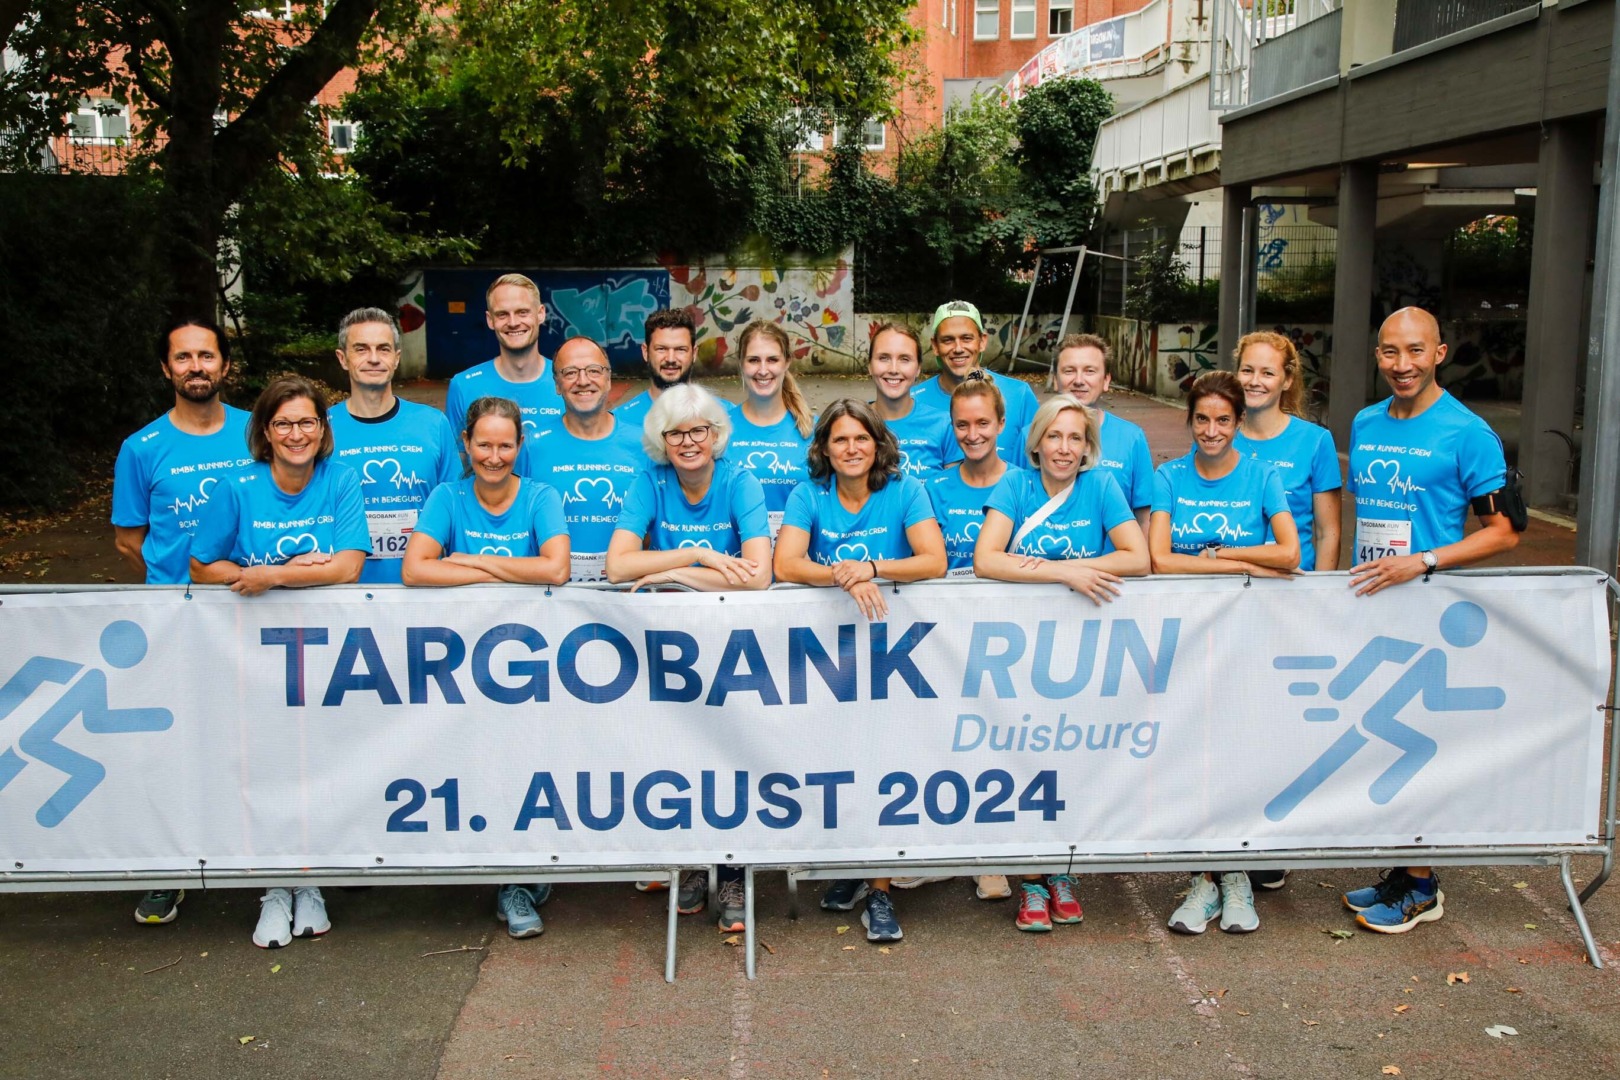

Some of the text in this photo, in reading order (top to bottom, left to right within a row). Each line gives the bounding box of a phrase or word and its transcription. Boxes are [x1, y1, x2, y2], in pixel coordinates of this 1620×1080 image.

[539, 407, 561, 415] CREW
[340, 445, 423, 457] RMBK RUNNING CREW
[1377, 444, 1407, 454] RUNNING
[1408, 447, 1432, 458] CREW
[170, 458, 256, 476] RMBK RUNNING CRE
[552, 463, 634, 473] RMBK RUNNING CREW
[1101, 459, 1123, 469] CREW
[1273, 460, 1294, 468] CREW
[371, 496, 380, 504] IN
[381, 495, 423, 504] BEWEGUNG
[1198, 499, 1229, 508] RUNNING
[1230, 500, 1251, 508] CREW
[1376, 499, 1418, 512] BEWEGUNG
[178, 519, 200, 529] SCHU
[253, 520, 277, 530] RMBK
[278, 517, 316, 530] RUNNING
[564, 515, 619, 523] ULE IN BEWEG
[1071, 519, 1091, 528] CREW
[681, 524, 711, 532] RUNNING
[868, 526, 888, 536] CREW
[370, 536, 408, 552] 162
[952, 569, 974, 577] TARGOB
[260, 617, 1182, 707] TARGOBANK RUN
[951, 712, 1161, 759] Duisburg
[384, 768, 1066, 833] 21. AUGUST 2024
